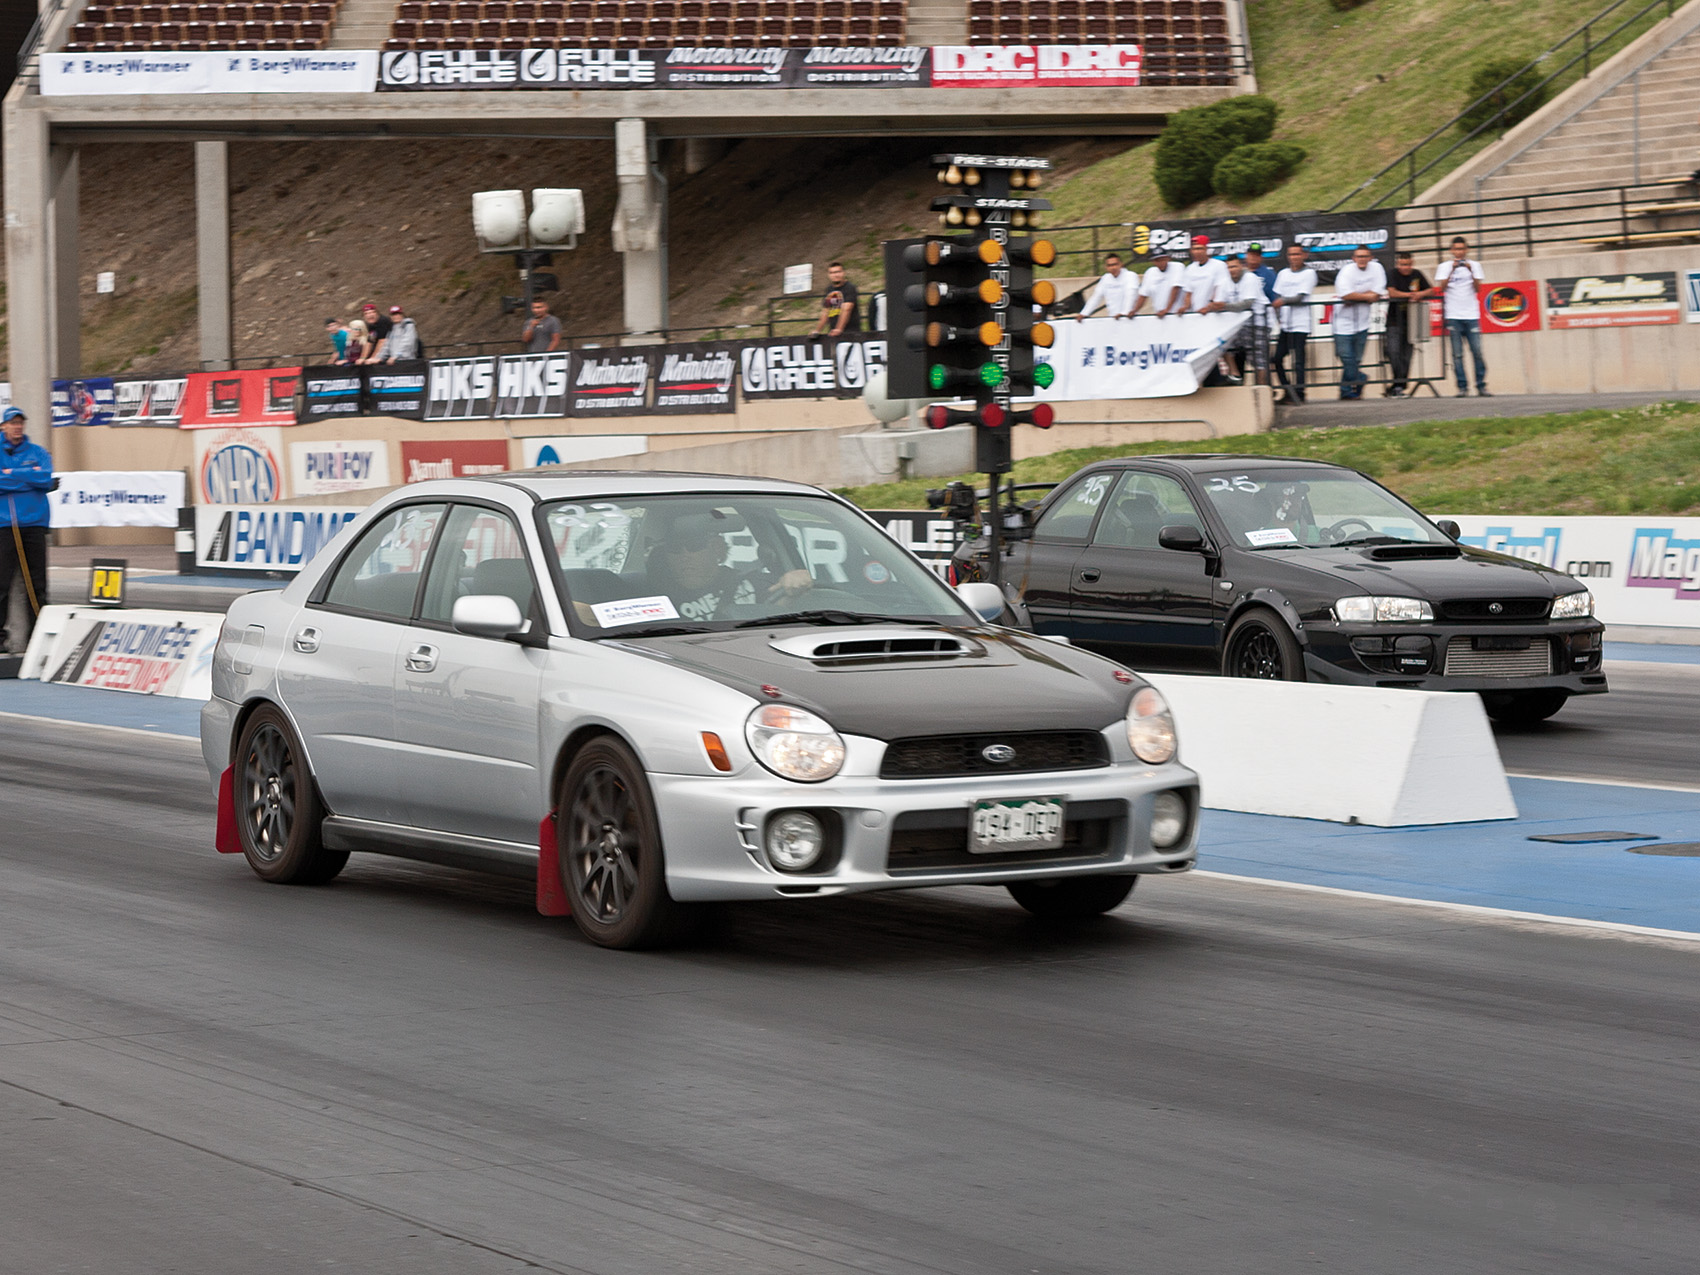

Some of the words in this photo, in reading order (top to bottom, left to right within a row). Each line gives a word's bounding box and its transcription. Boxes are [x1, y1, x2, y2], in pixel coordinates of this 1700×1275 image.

[420, 50, 516, 66] FULL
[558, 49, 655, 65] FULL
[84, 60, 191, 76] BorgWarner
[250, 58, 357, 74] BorgWarner
[558, 65, 656, 81] RACE
[420, 66, 517, 83] RACE
[669, 73, 782, 82] DISTRIBUTION
[807, 73, 920, 81] DISTRIBUTION
[953, 156, 1049, 168] PRE-STAGE
[975, 198, 1029, 208] STAGE
[767, 344, 834, 367] FULL
[430, 361, 495, 401] HKS
[498, 359, 568, 398] HKS
[768, 367, 836, 391] RACE
[1209, 475, 1261, 494] 25
[79, 490, 167, 506] BorgWarner
